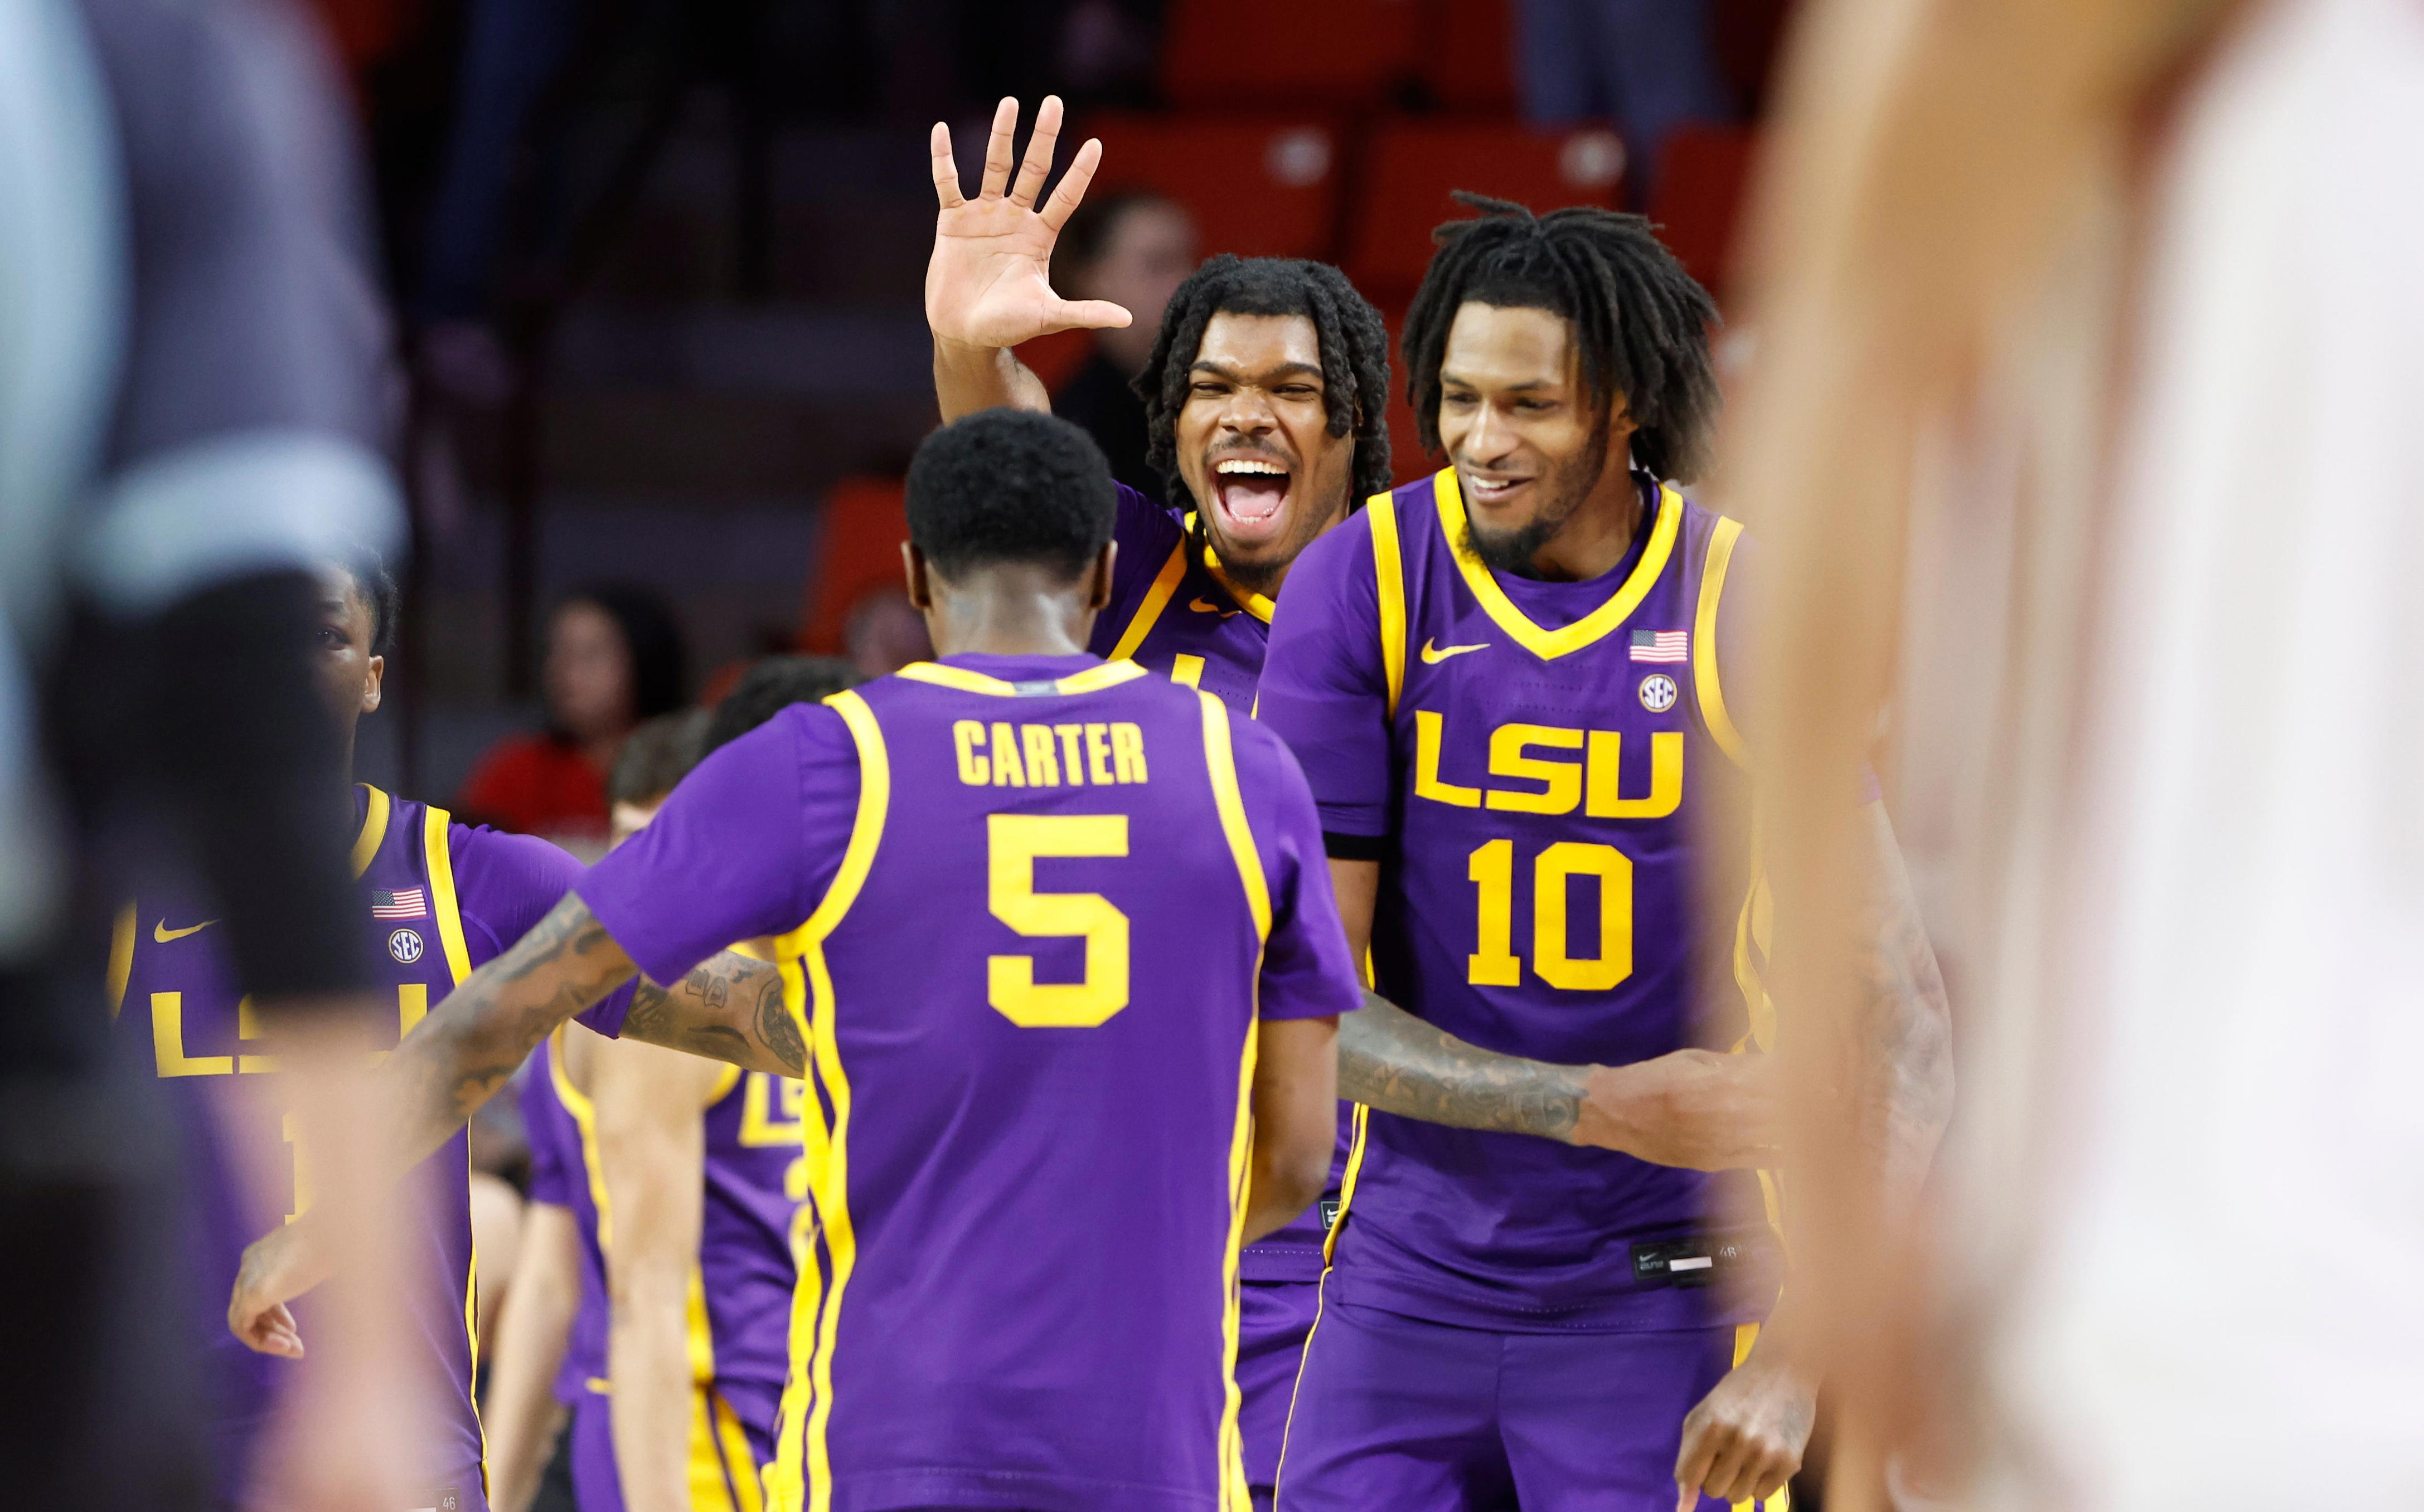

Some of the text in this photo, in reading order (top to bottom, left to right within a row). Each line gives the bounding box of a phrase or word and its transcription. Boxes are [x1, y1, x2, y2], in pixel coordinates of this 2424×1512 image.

[1644, 677, 1673, 708] SEC
[953, 719, 1148, 787] CARTER
[1414, 710, 1684, 819] LSU
[391, 931, 420, 960] SEC
[987, 814, 1129, 1028] 5
[1467, 839, 1633, 991] 10
[443, 1496, 456, 1510] 46
